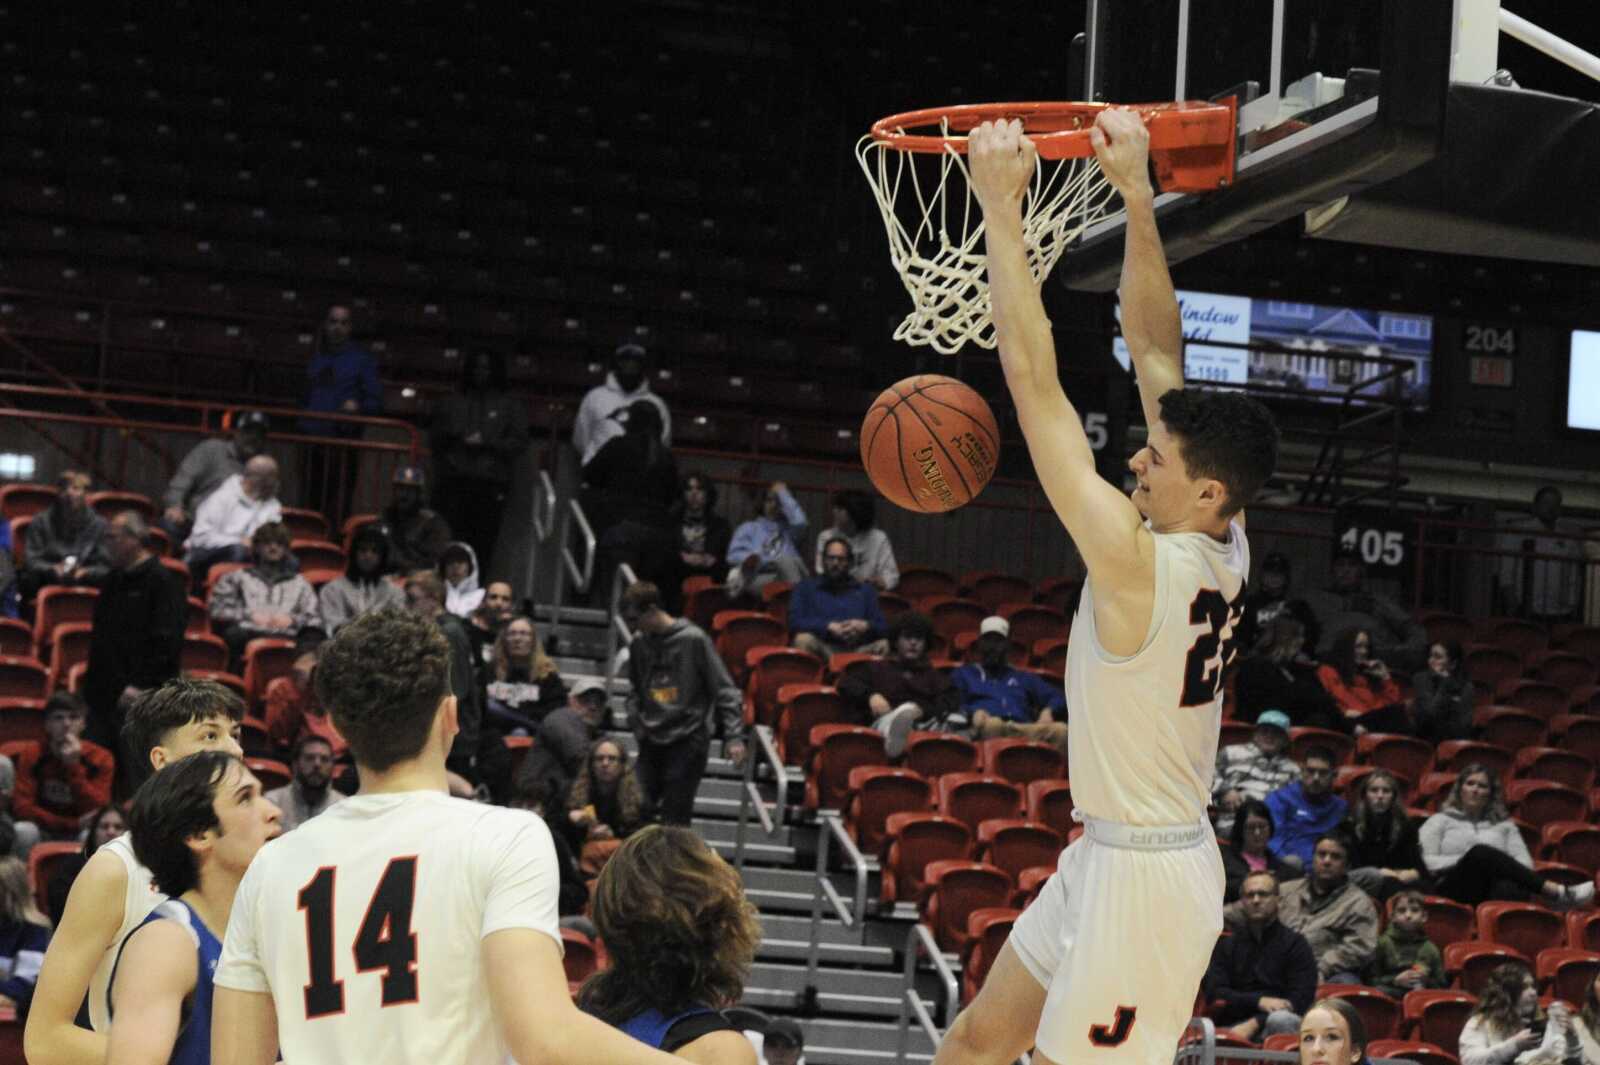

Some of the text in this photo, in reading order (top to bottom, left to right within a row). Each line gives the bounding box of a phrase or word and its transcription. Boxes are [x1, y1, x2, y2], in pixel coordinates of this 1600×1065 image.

[1179, 299, 1240, 325] indow
[1465, 325, 1515, 353] 204
[297, 854, 420, 1021] 14
[1088, 1005, 1137, 1048] J
